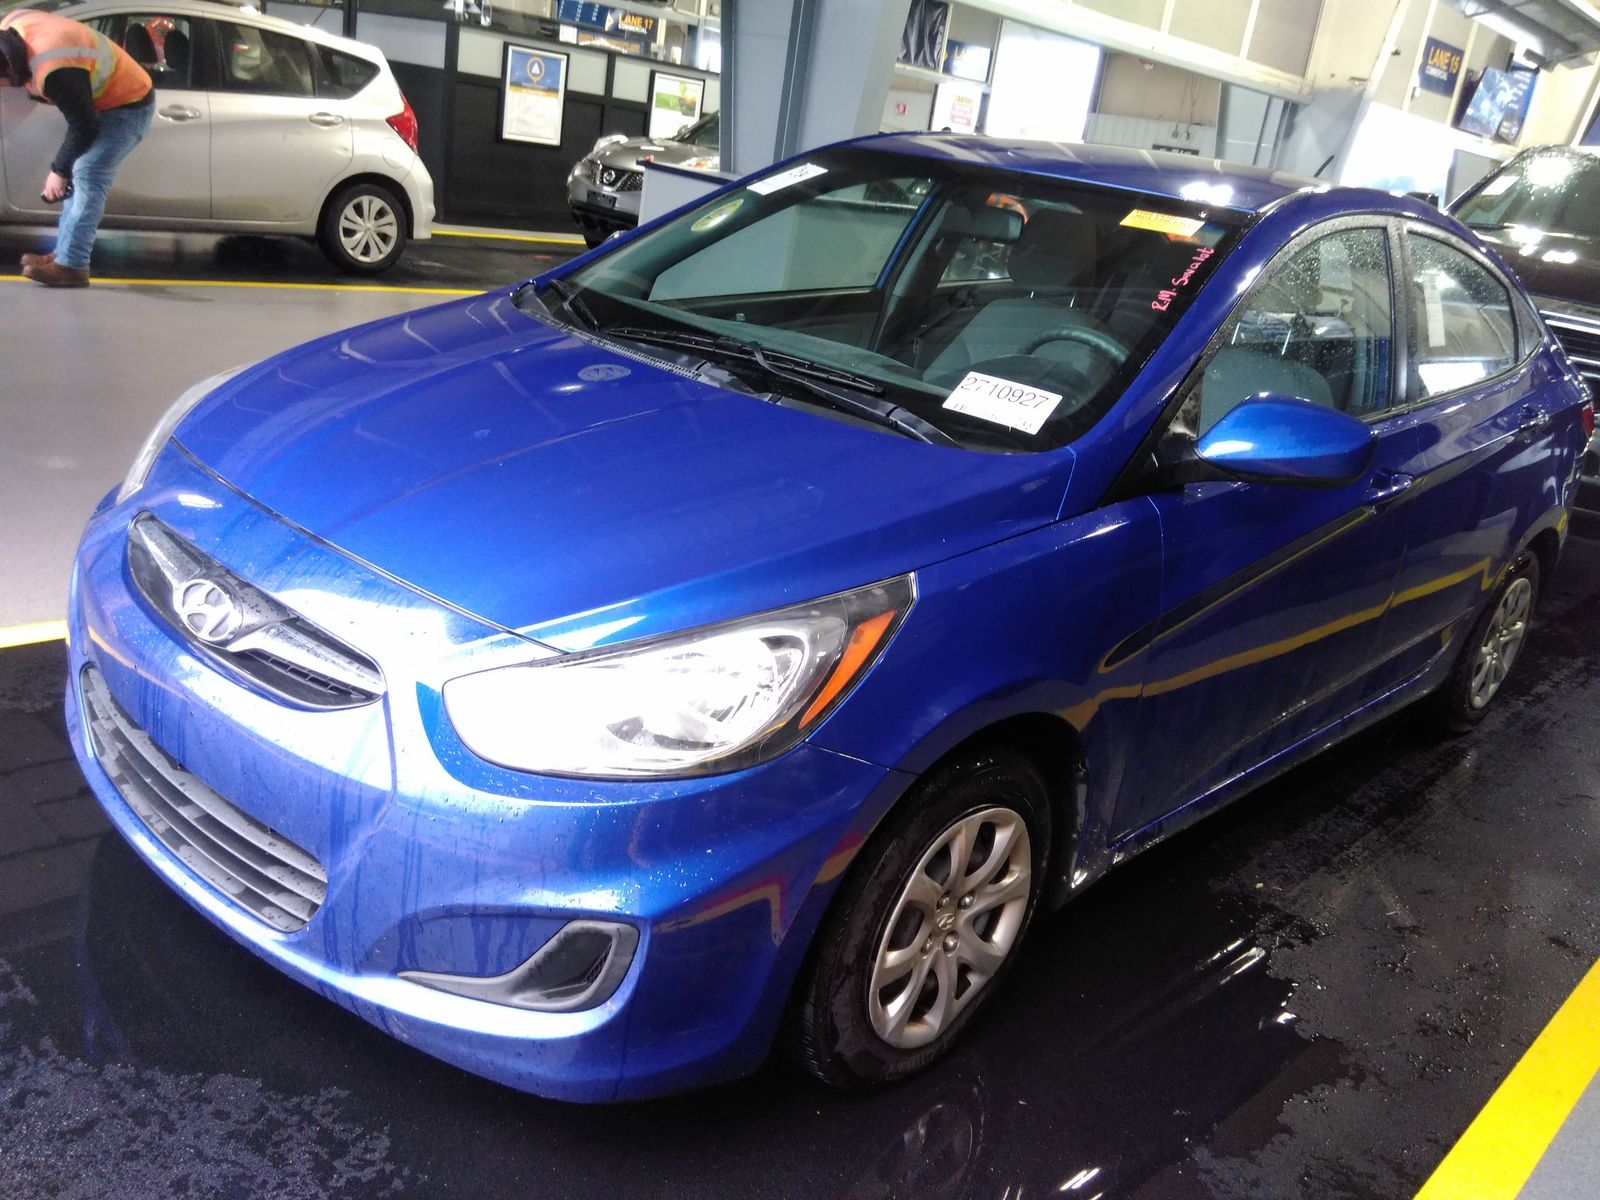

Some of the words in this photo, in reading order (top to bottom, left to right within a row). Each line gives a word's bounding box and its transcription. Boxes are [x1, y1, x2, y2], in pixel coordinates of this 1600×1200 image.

[618, 12, 643, 29] LANE
[644, 17, 654, 30] 17
[1427, 46, 1451, 71] LANE
[960, 376, 1049, 409] 2710927
